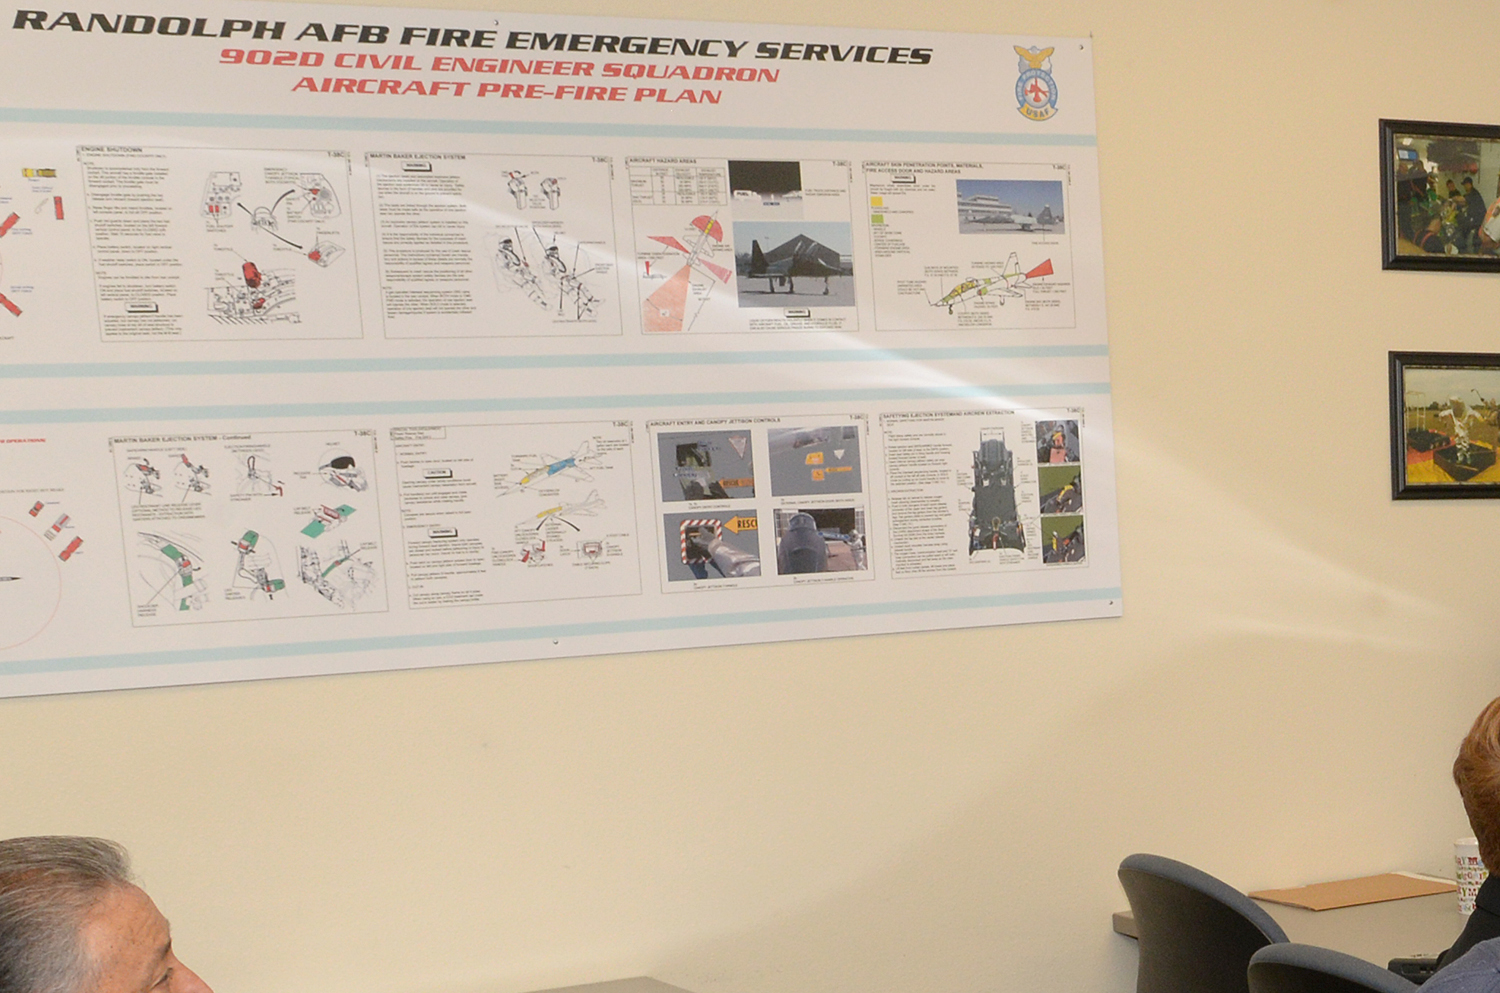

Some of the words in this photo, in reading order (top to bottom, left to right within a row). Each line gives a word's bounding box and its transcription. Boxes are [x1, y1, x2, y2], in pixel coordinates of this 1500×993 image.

[12, 9, 287, 40] RANDOLPH
[294, 22, 390, 44] AFB
[399, 26, 498, 48] FIRE
[505, 30, 749, 58] EMERGENCY
[754, 41, 933, 65] SERVICES
[219, 48, 324, 67] 902D
[334, 53, 422, 71] CIVIL
[431, 56, 595, 76] ENGINEER
[601, 62, 780, 82] SQUADRON
[291, 76, 471, 97] AIRCRAFT
[476, 82, 628, 101] PRE-FIRE
[633, 87, 722, 104] PLAN
[1026, 107, 1050, 118] USAF
